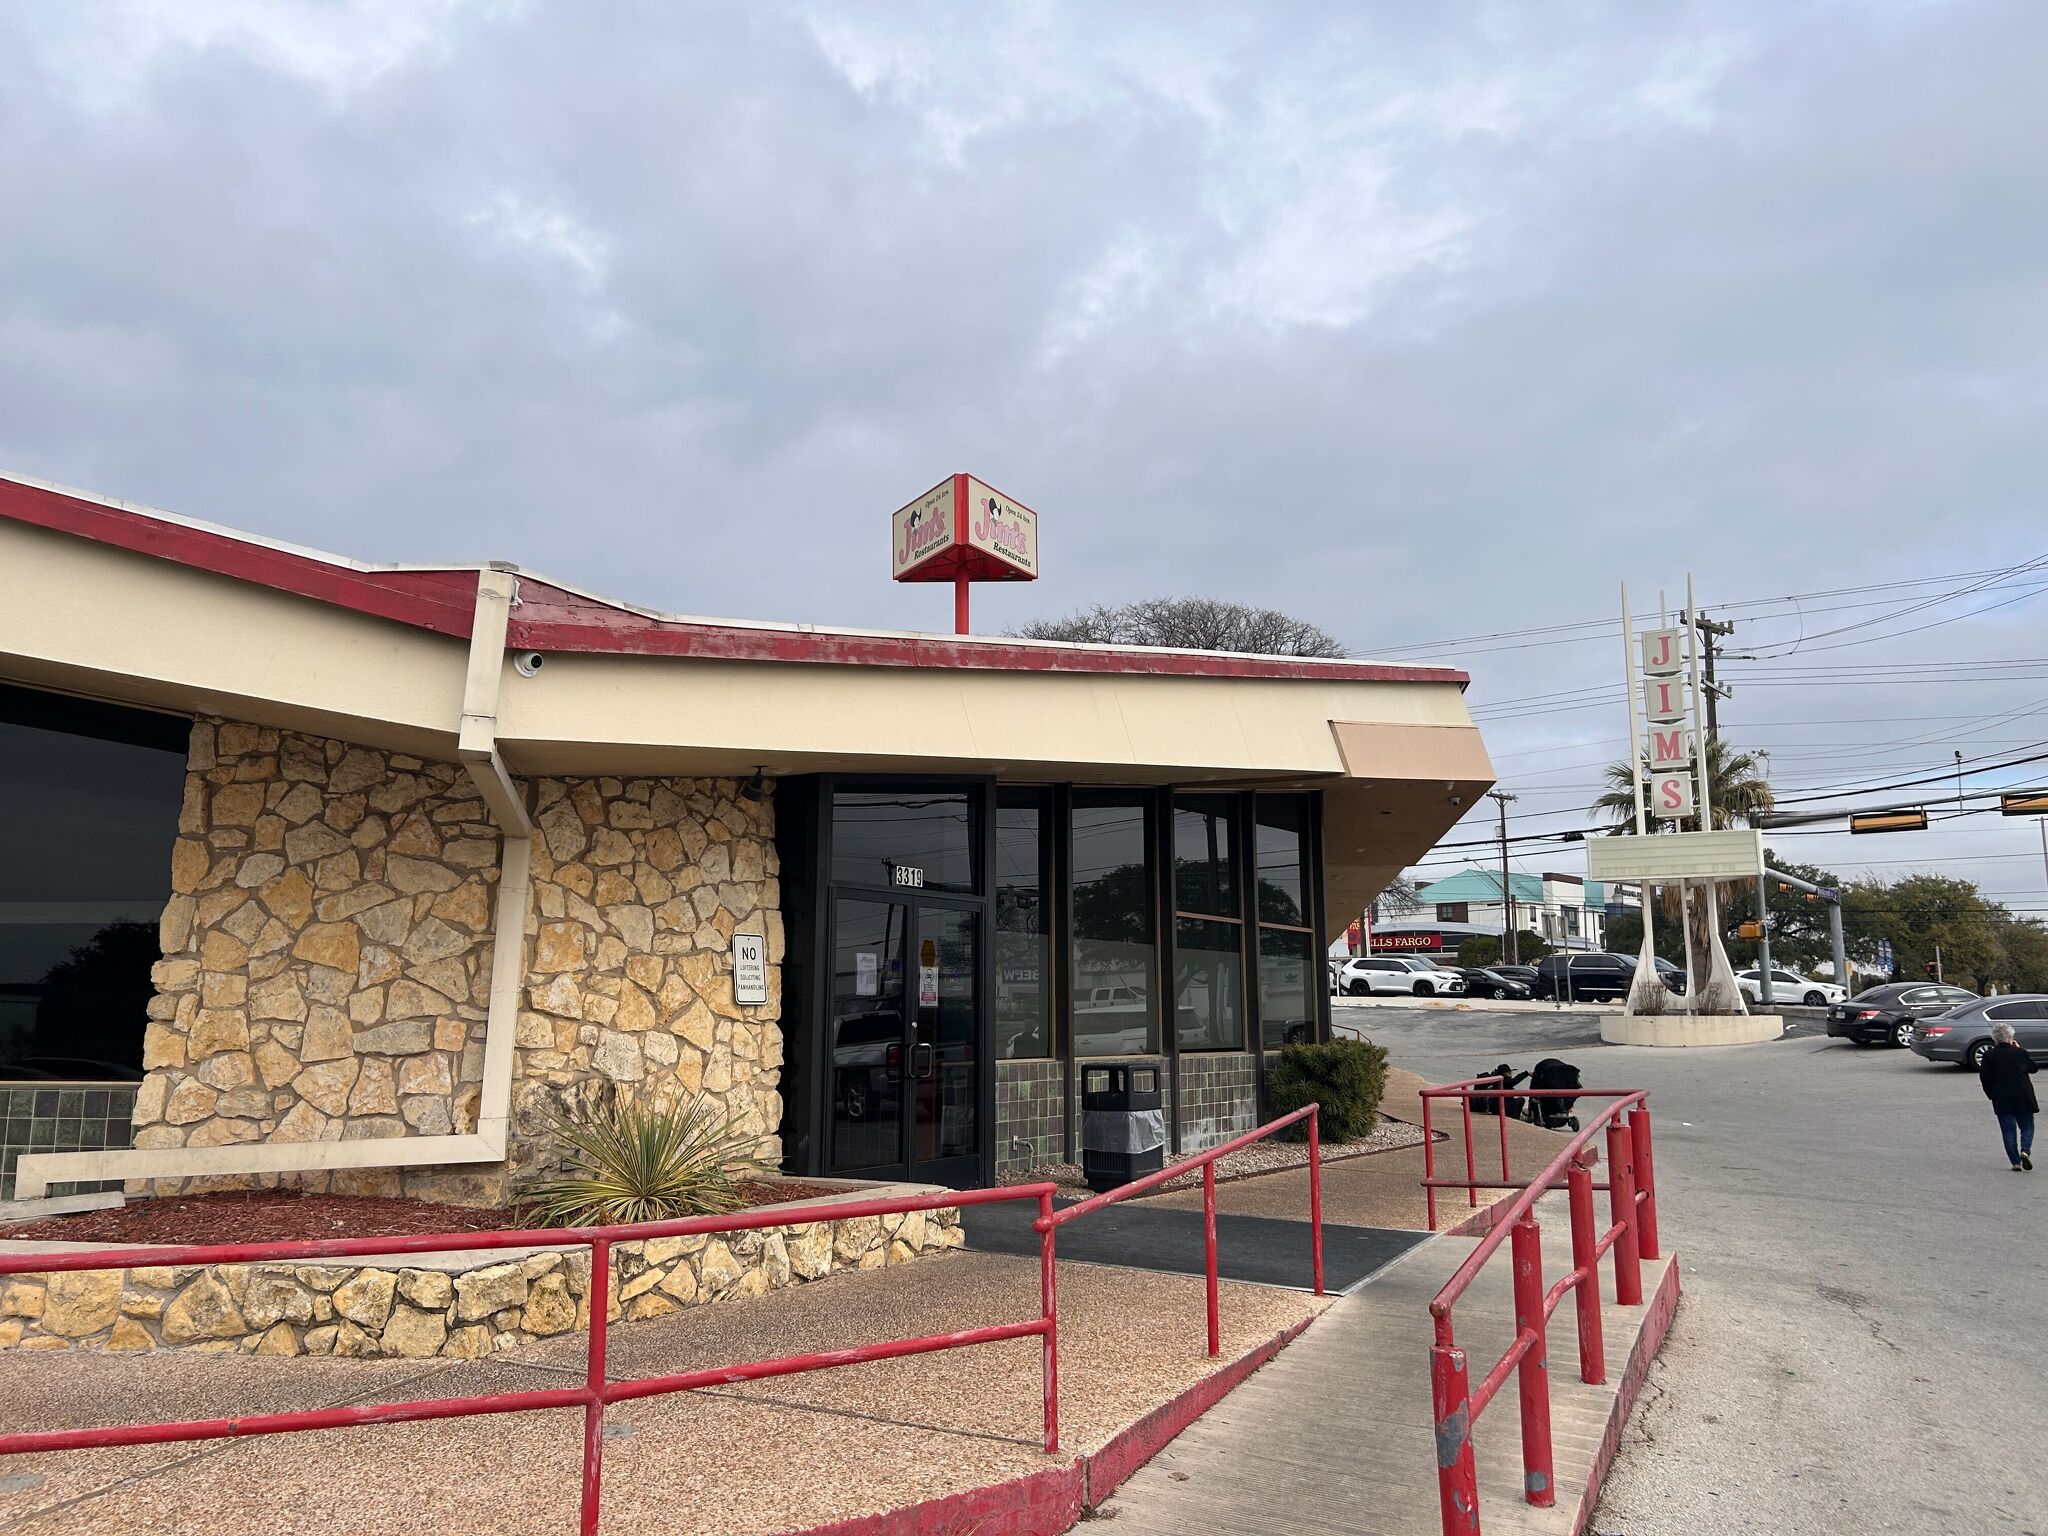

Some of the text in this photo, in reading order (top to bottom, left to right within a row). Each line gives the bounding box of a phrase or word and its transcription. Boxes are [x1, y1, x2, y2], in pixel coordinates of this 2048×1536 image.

[1005, 505, 1017, 516] Open
[899, 506, 945, 565] Jim's
[975, 497, 1027, 555] Jim's
[914, 533, 950, 561] Restaurants
[993, 541, 1032, 568] Restaurants
[897, 866, 922, 886] 3319
[742, 947, 756, 960] NO
[1394, 937, 1431, 947] FARGO
